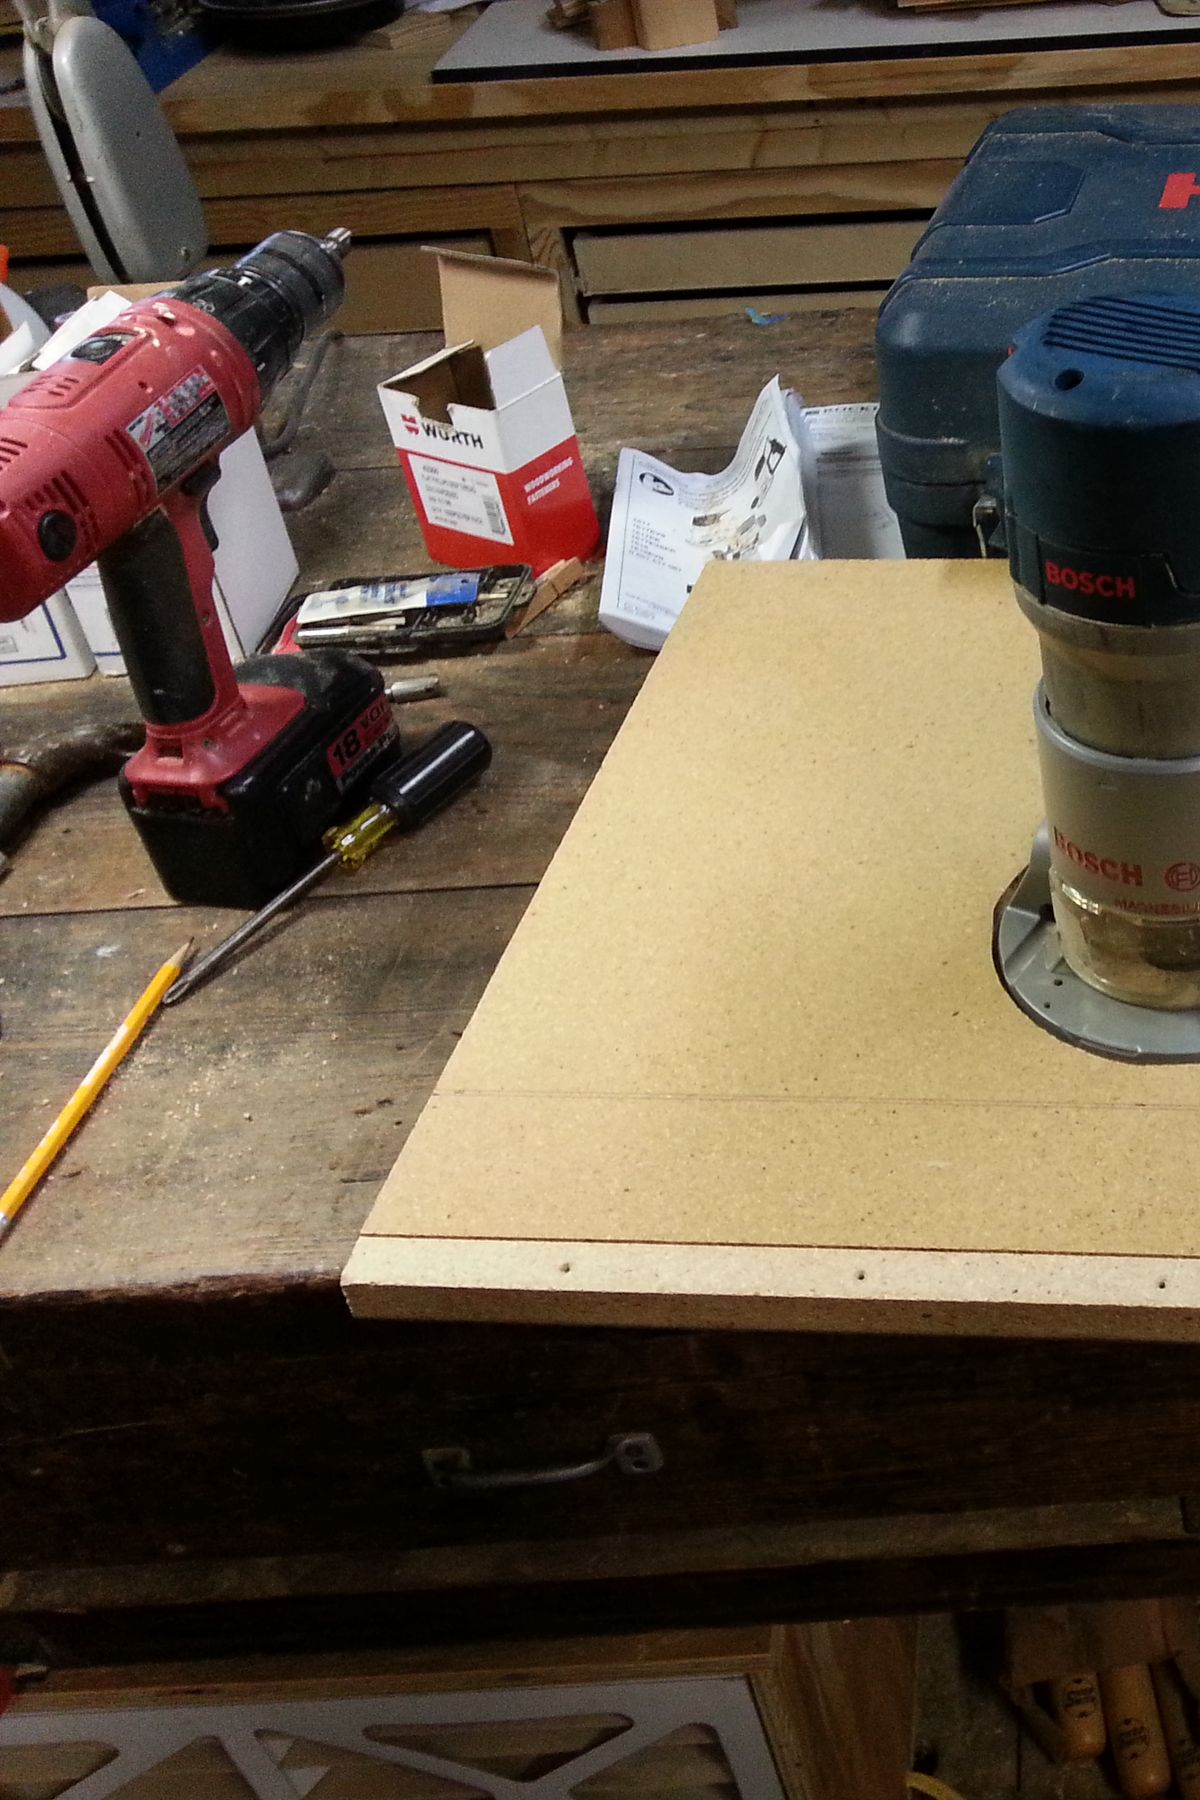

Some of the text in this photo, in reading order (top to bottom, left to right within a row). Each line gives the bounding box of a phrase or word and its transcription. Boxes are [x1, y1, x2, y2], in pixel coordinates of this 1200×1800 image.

[1044, 559, 1136, 599] BOSCH
[333, 728, 361, 766] 18
[1053, 825, 1144, 887] BOSCH
